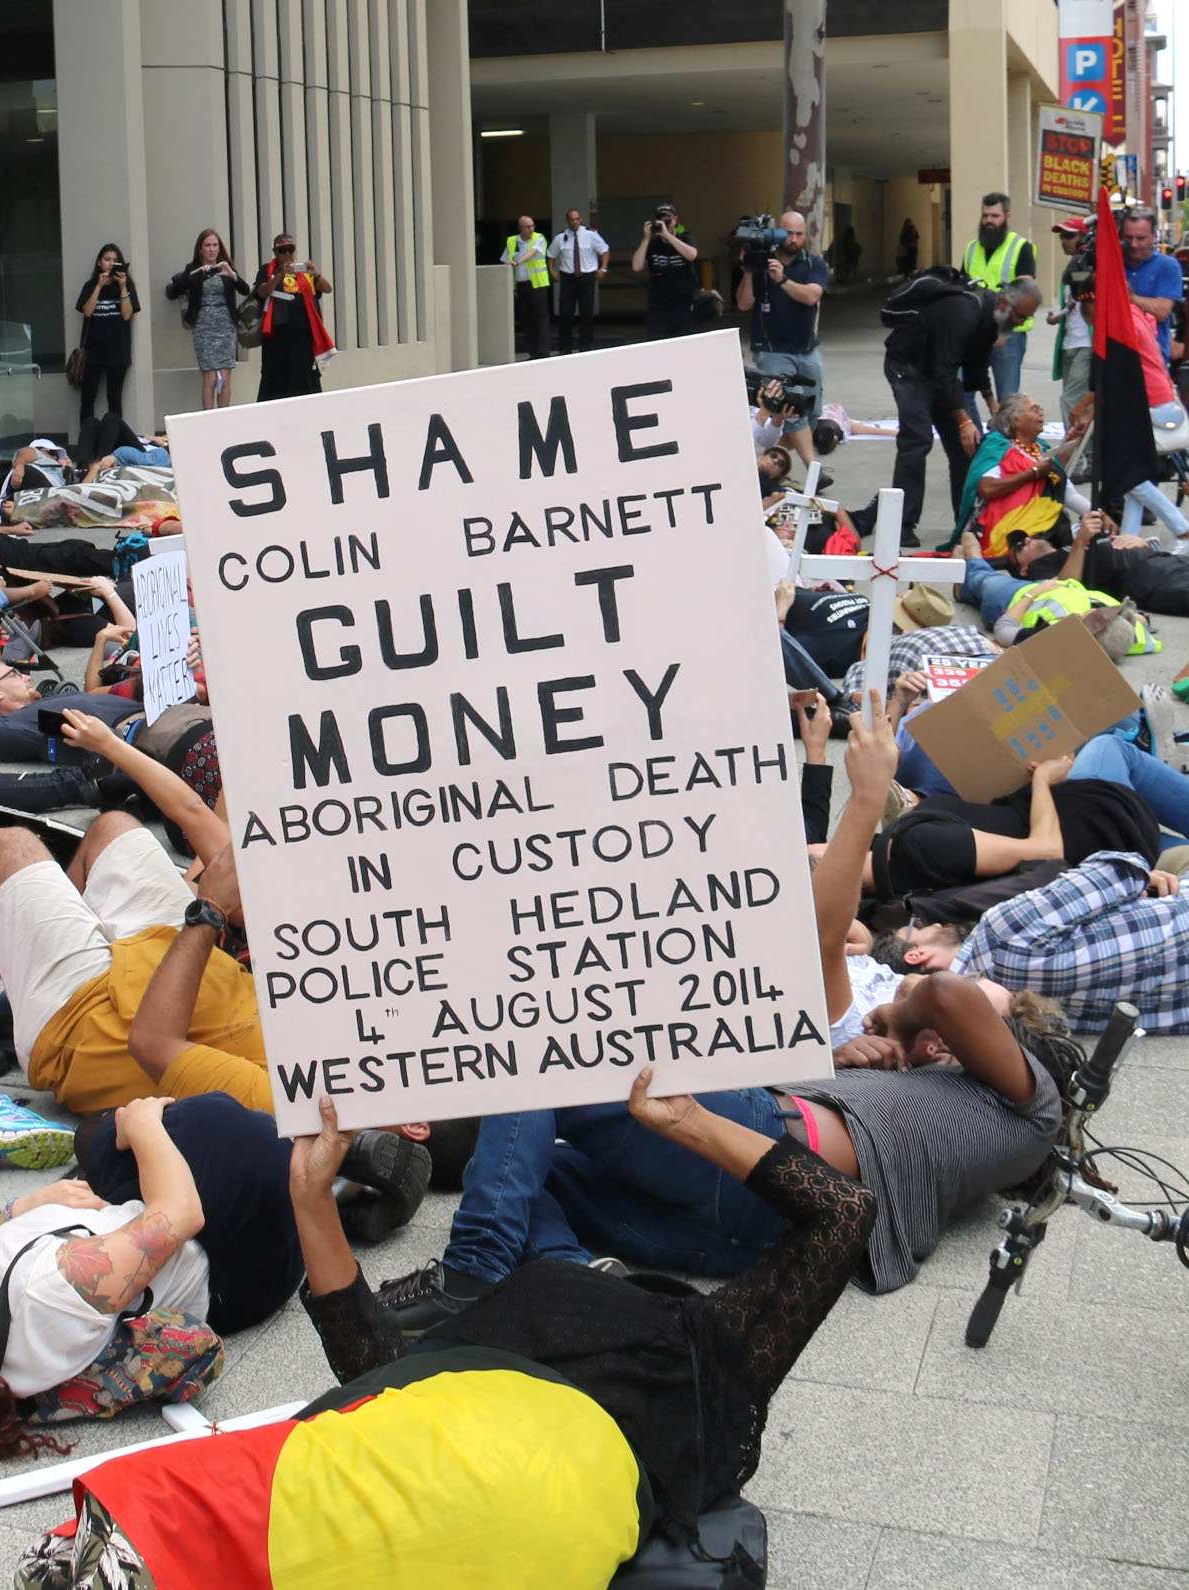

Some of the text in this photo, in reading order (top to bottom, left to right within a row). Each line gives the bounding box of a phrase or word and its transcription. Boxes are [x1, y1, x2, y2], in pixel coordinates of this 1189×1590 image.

[1075, 50, 1097, 75] P
[1043, 155, 1091, 174] BLACK
[1043, 172, 1089, 188] DEATHS
[1045, 134, 1092, 153] STOP
[221, 380, 679, 518] SHAME
[219, 483, 722, 591] COLIN BARNETT
[136, 561, 187, 619] ABORIGINAL
[296, 565, 634, 680] GUILT
[150, 612, 181, 660] LIVES
[148, 657, 192, 712] MATTER
[288, 664, 681, 789] MONEY
[242, 744, 787, 849] ABORIGINAL DEATH
[346, 814, 716, 893] IN CUSTODY
[274, 868, 779, 960] SOUTH HEDLAND
[267, 921, 735, 1008] POLICE STATION
[432, 980, 645, 1037] AUGUST
[679, 967, 784, 1011] 2014
[278, 1010, 824, 1103] WESTERN AUSTRALIA
